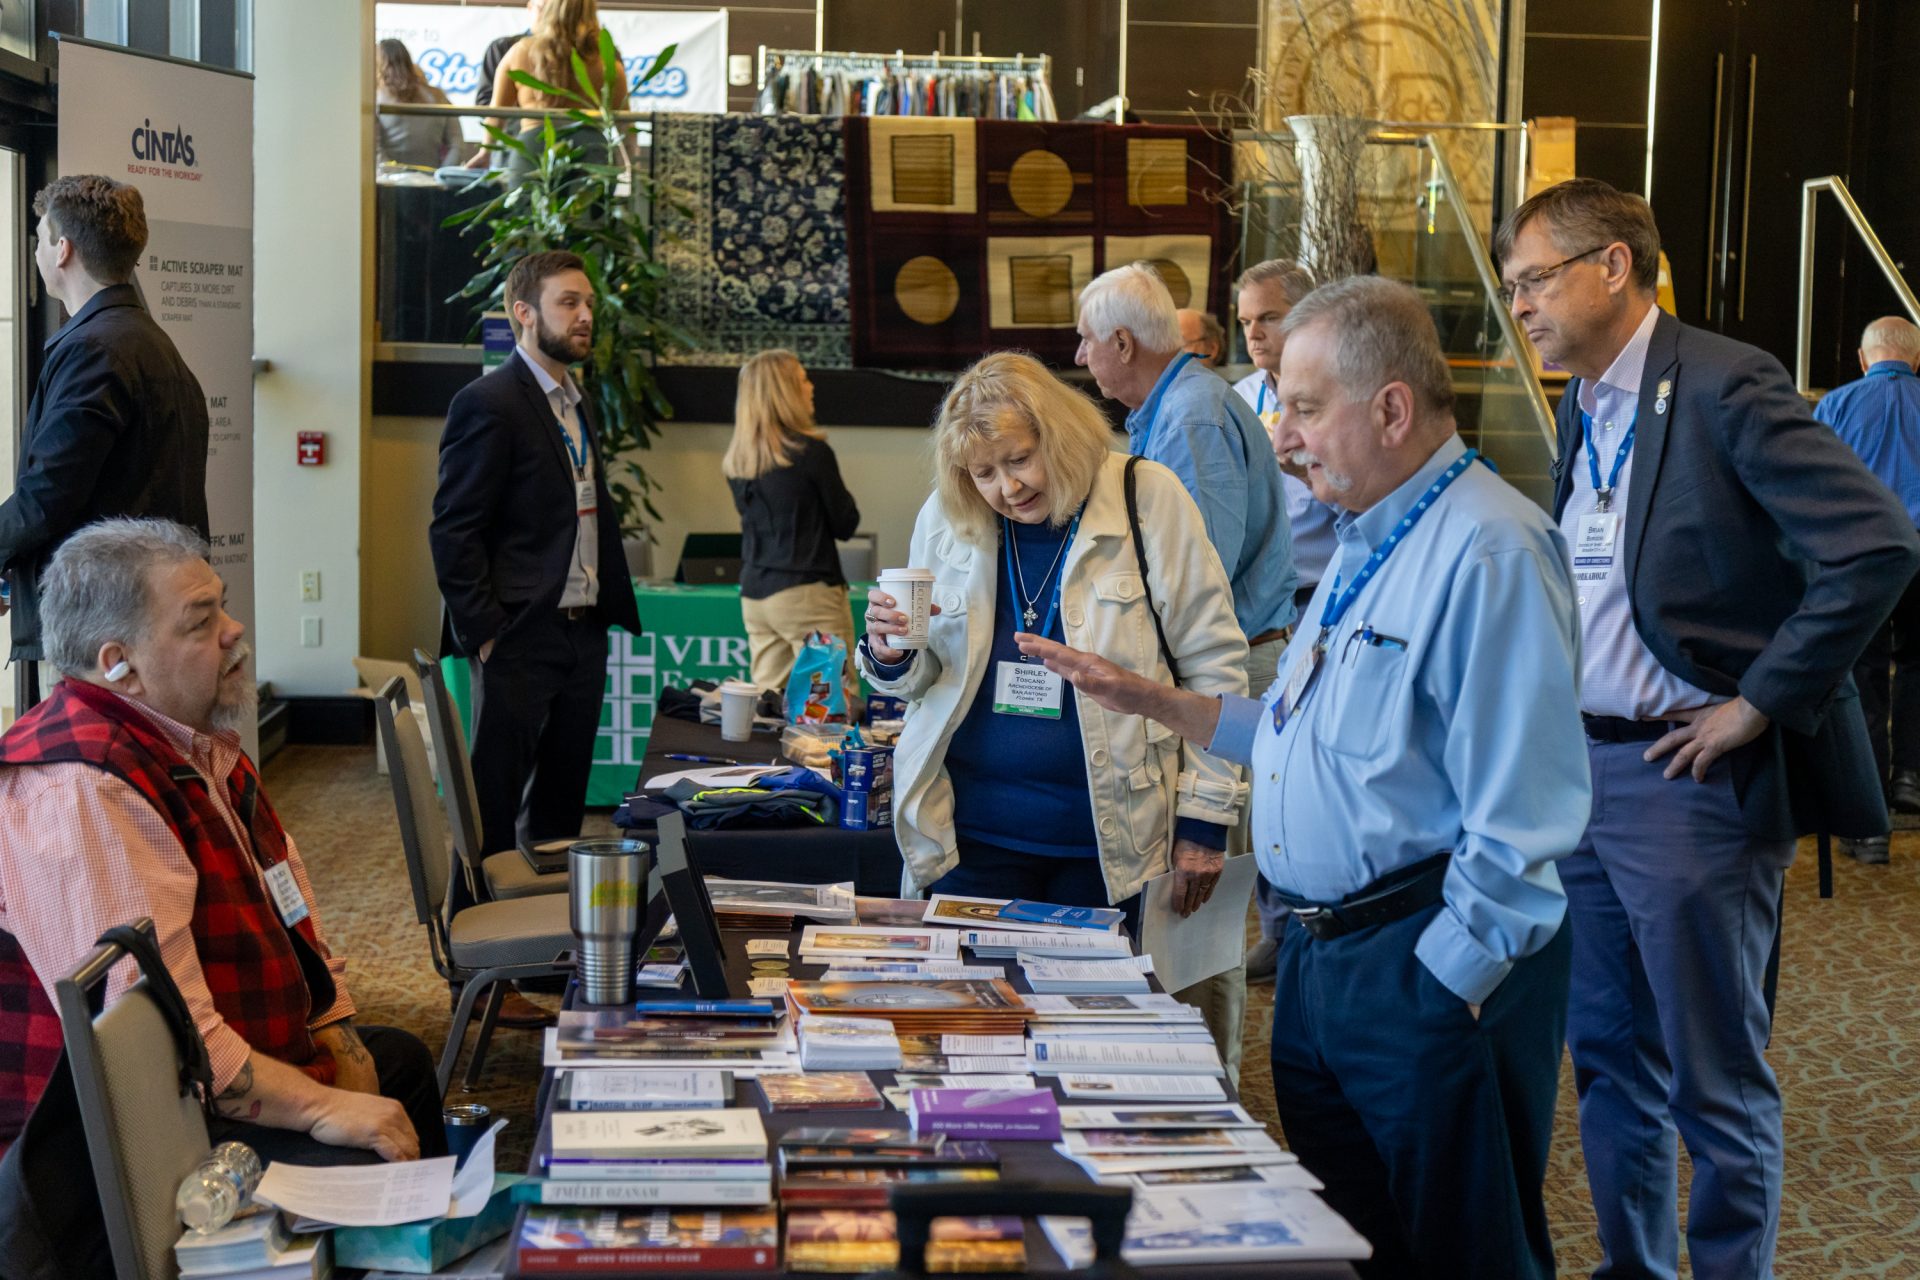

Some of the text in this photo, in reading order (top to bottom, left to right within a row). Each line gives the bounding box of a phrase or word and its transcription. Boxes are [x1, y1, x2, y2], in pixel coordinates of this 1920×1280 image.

[417, 47, 482, 94] Sto
[127, 164, 203, 181] READY FOR THE WORKDAY
[160, 260, 243, 277] ACTIVE SCRAPER MAT
[160, 281, 192, 293] CAPTURES
[201, 284, 220, 294] MORE
[221, 284, 235, 295] DIRT
[161, 296, 174, 307] AND
[210, 397, 228, 408] MAT
[229, 533, 244, 545] MAT
[1014, 667, 1048, 677] SHIRLEY
[1016, 676, 1045, 684] TOSCANO
